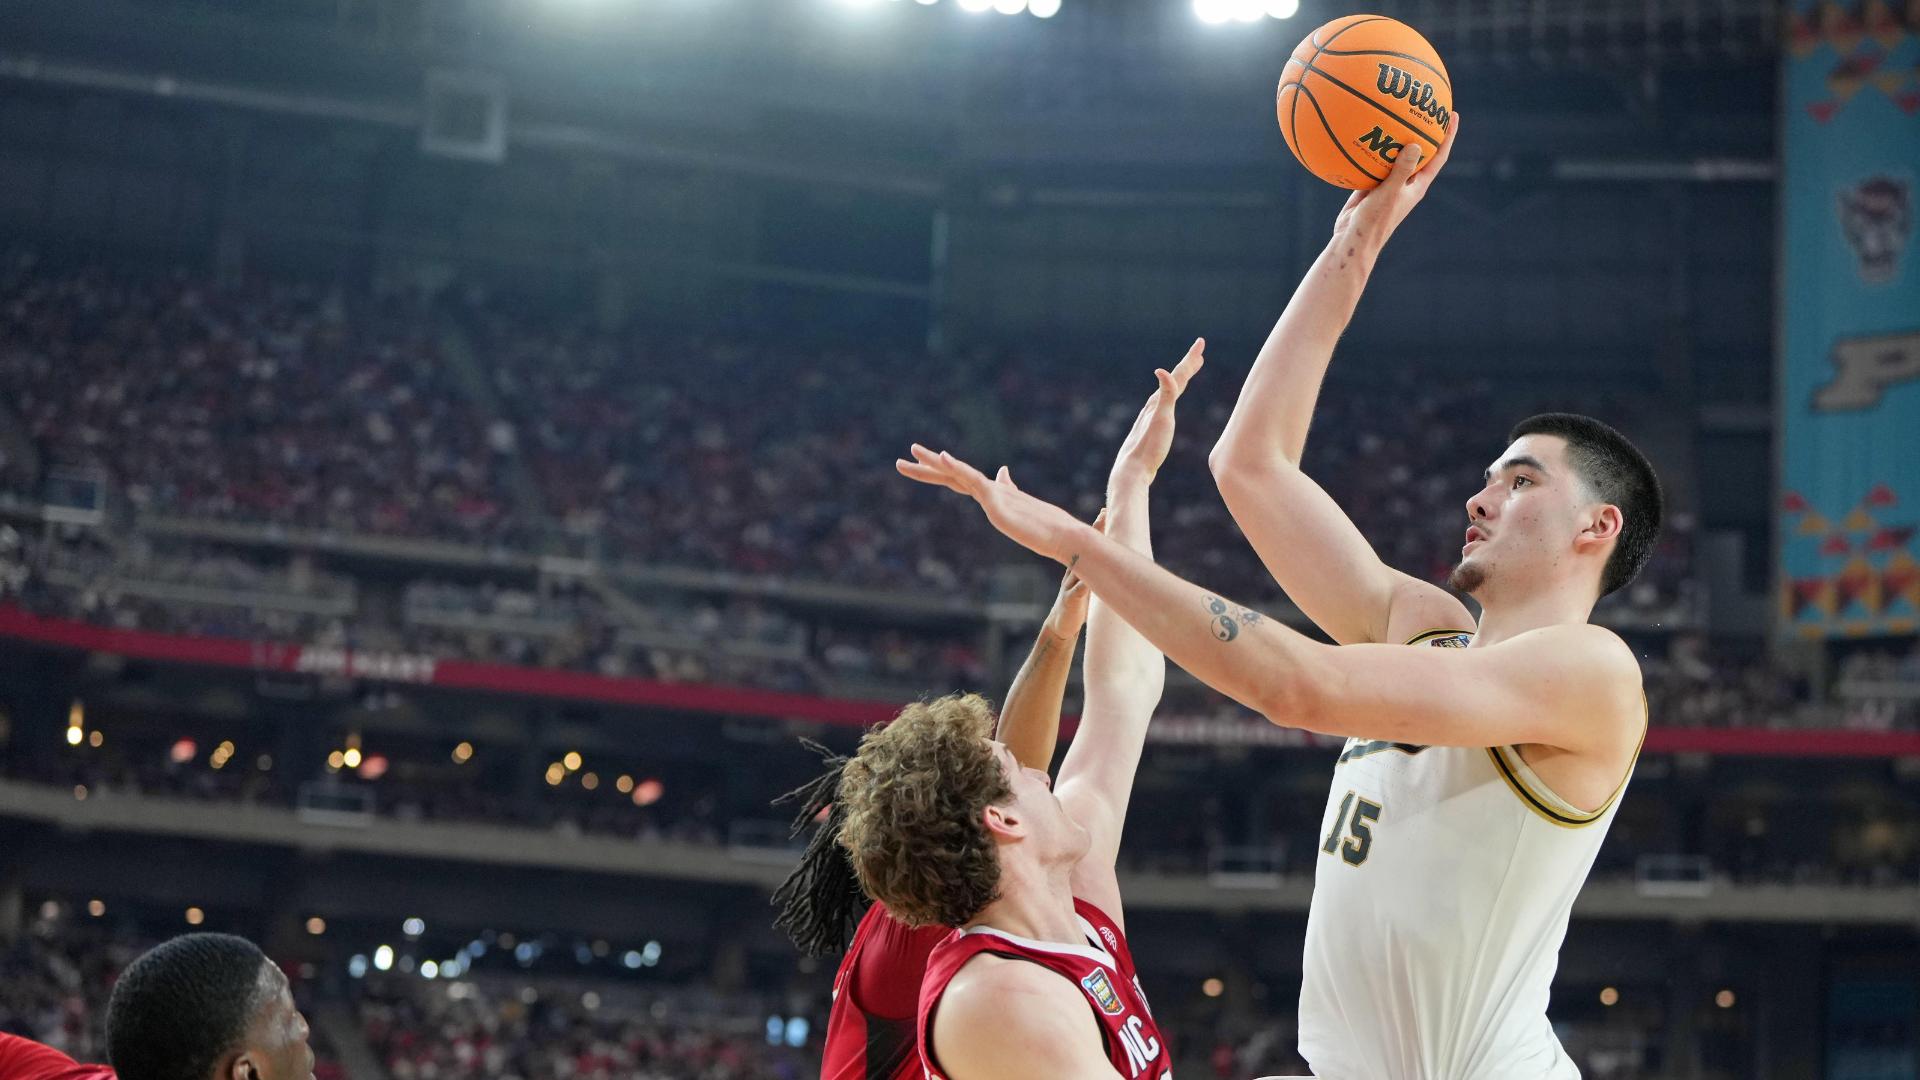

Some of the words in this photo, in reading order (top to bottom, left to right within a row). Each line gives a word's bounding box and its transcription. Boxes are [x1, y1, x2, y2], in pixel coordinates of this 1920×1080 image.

[1377, 63, 1450, 133] Wilson
[1359, 126, 1424, 167] NC
[1322, 790, 1382, 867] 15
[1118, 1015, 1160, 1079] NC
